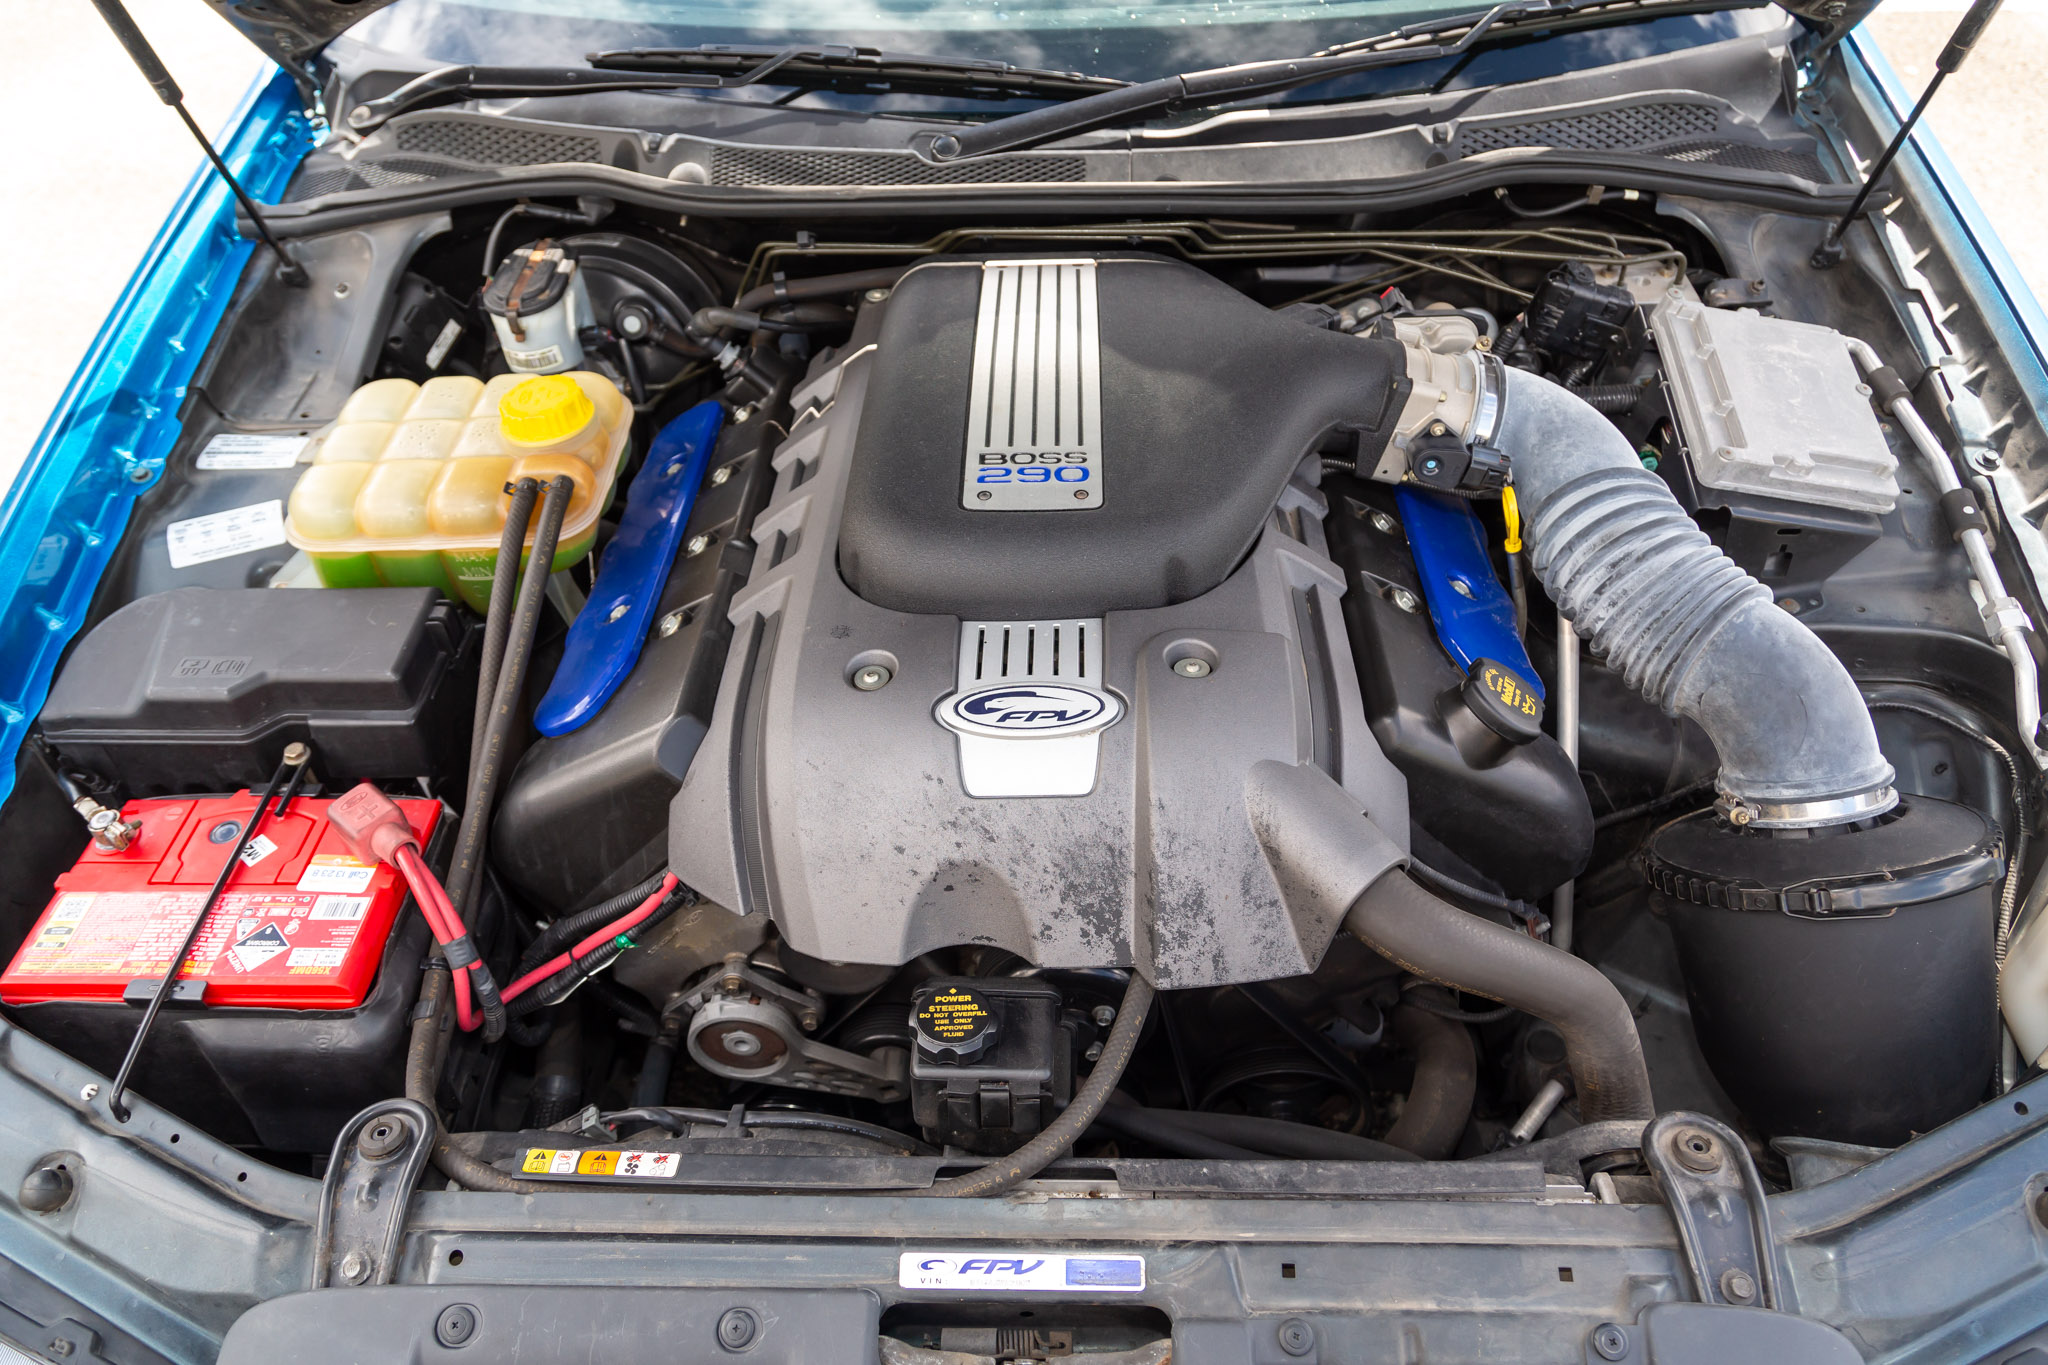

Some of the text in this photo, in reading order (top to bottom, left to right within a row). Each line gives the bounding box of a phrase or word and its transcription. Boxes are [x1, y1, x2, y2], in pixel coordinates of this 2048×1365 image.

[978, 451, 1088, 465] BOSS
[976, 466, 1090, 484] 290
[996, 709, 1092, 723] FPV
[935, 995, 972, 1003] POWER
[928, 1003, 979, 1012] STEERING
[952, 1010, 988, 1018] OVERFILL
[934, 1024, 974, 1032] APPROVED
[958, 1259, 1045, 1275] FPV
